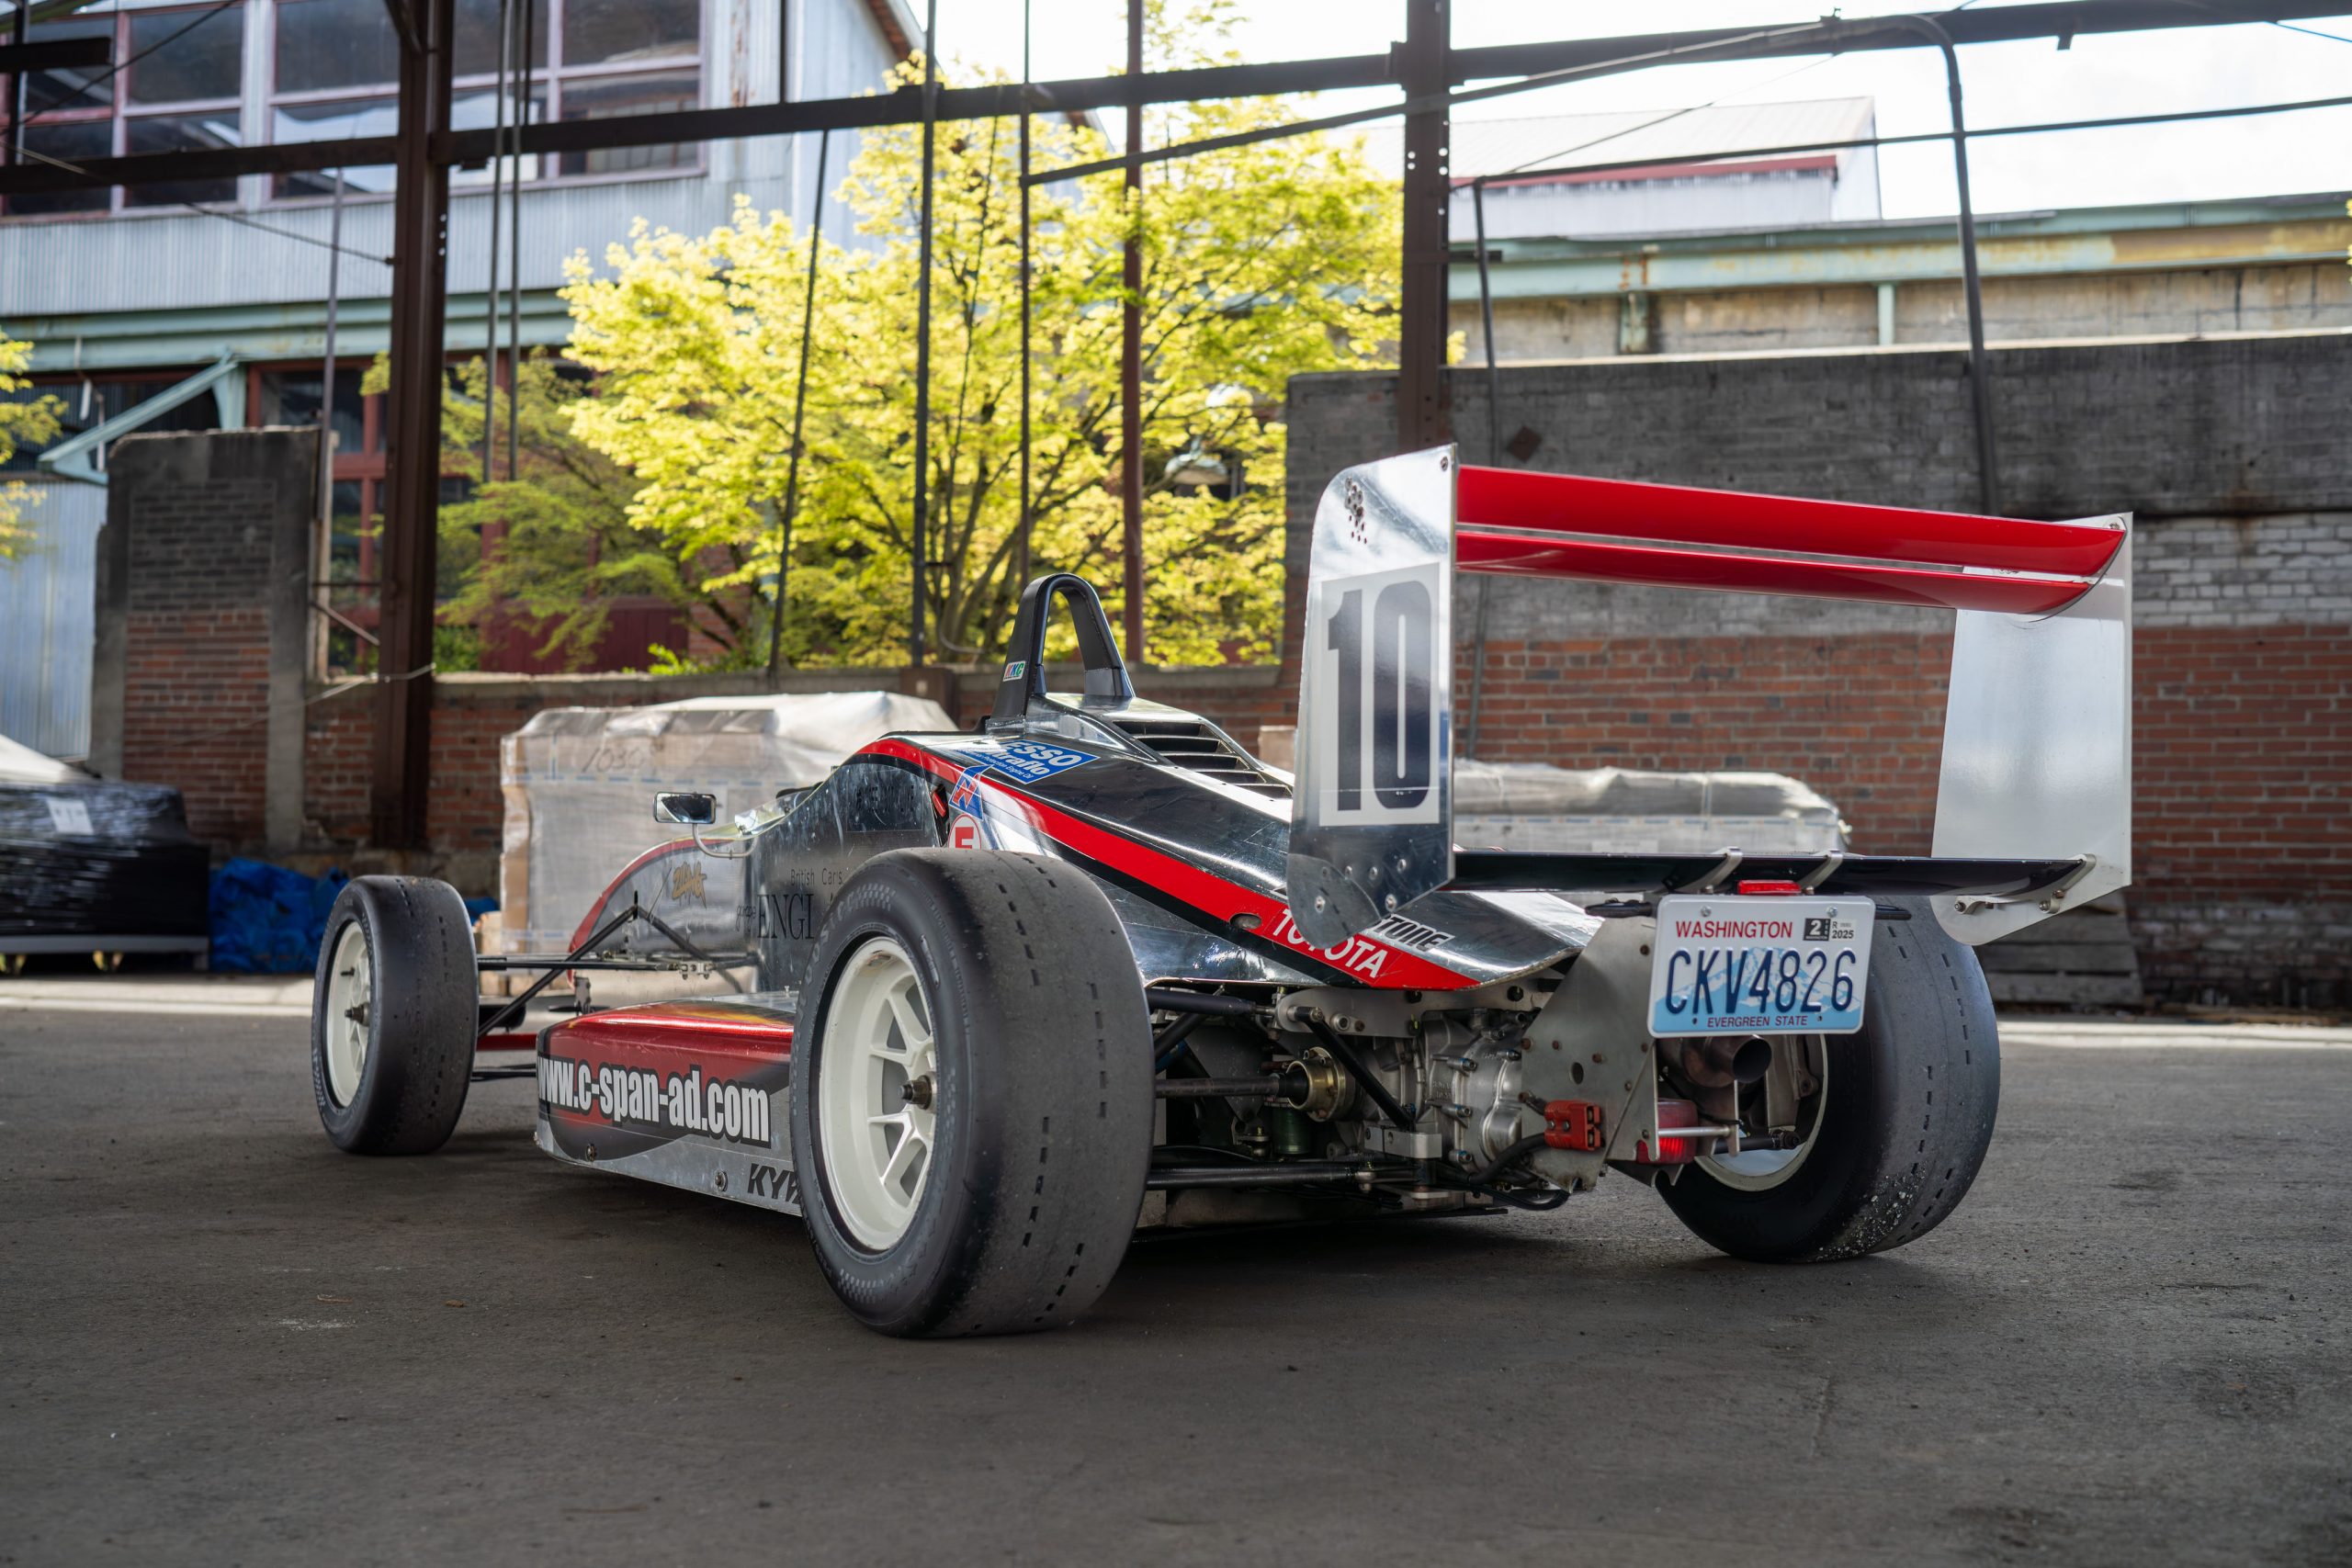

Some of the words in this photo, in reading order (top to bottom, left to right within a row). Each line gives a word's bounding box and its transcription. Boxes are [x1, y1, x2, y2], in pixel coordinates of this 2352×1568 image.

[1328, 580, 1431, 811] 10
[987, 750, 1050, 774] traflo
[791, 868, 815, 886] British
[1676, 920, 1792, 939] WASHINGTON
[1809, 919, 1821, 936] 2
[1832, 930, 1854, 939] 2025
[1272, 908, 1388, 978] TOOTA
[1666, 947, 1857, 1015] CKV4826
[1707, 1016, 1770, 1028] EVERGREEN
[1775, 1015, 1808, 1026] STATE
[537, 1055, 770, 1143] www.c-span-ad.com
